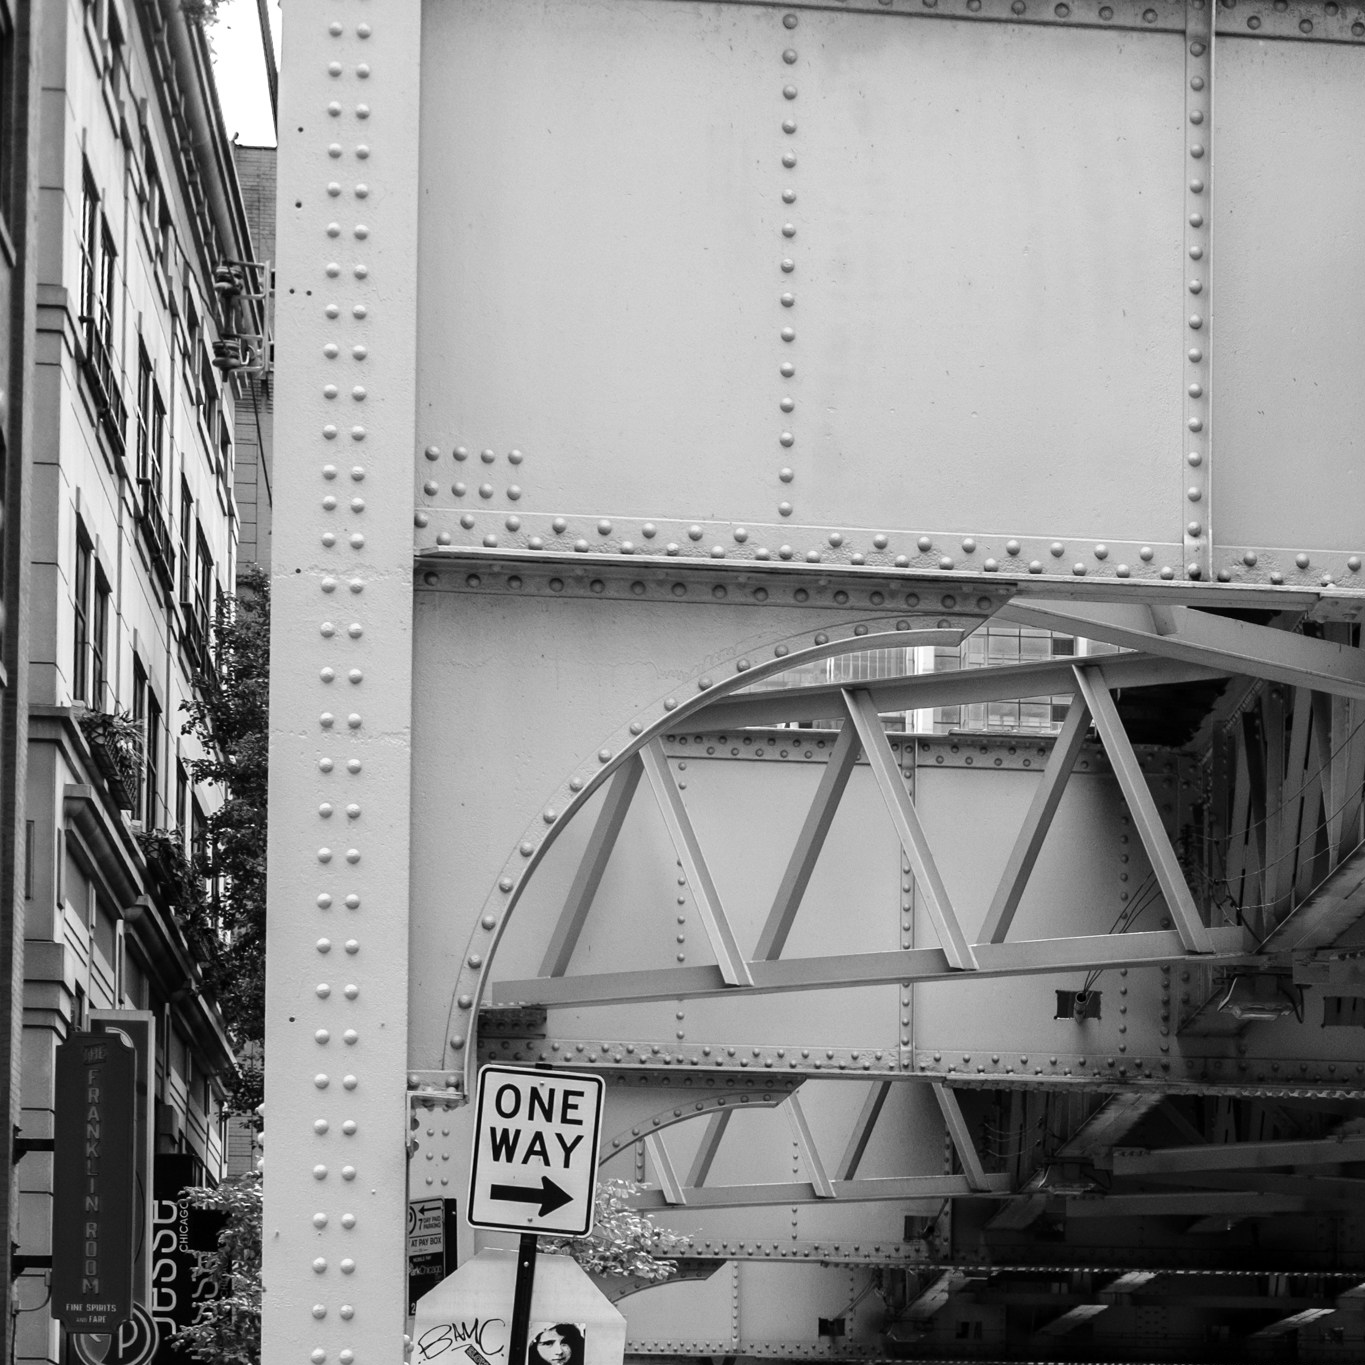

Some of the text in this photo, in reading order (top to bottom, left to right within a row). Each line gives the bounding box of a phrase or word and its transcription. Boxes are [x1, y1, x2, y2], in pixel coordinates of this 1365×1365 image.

[495, 1083, 584, 1126] ONE
[490, 1126, 584, 1169] WAY
[82, 1069, 101, 1295] FRANKLIN ROOM
[418, 1218, 423, 1230] 7
[419, 1238, 428, 1246] PAY
[430, 1236, 442, 1245] BOX
[66, 1303, 117, 1313] FINE SPIRITS
[88, 1315, 107, 1324] FARE
